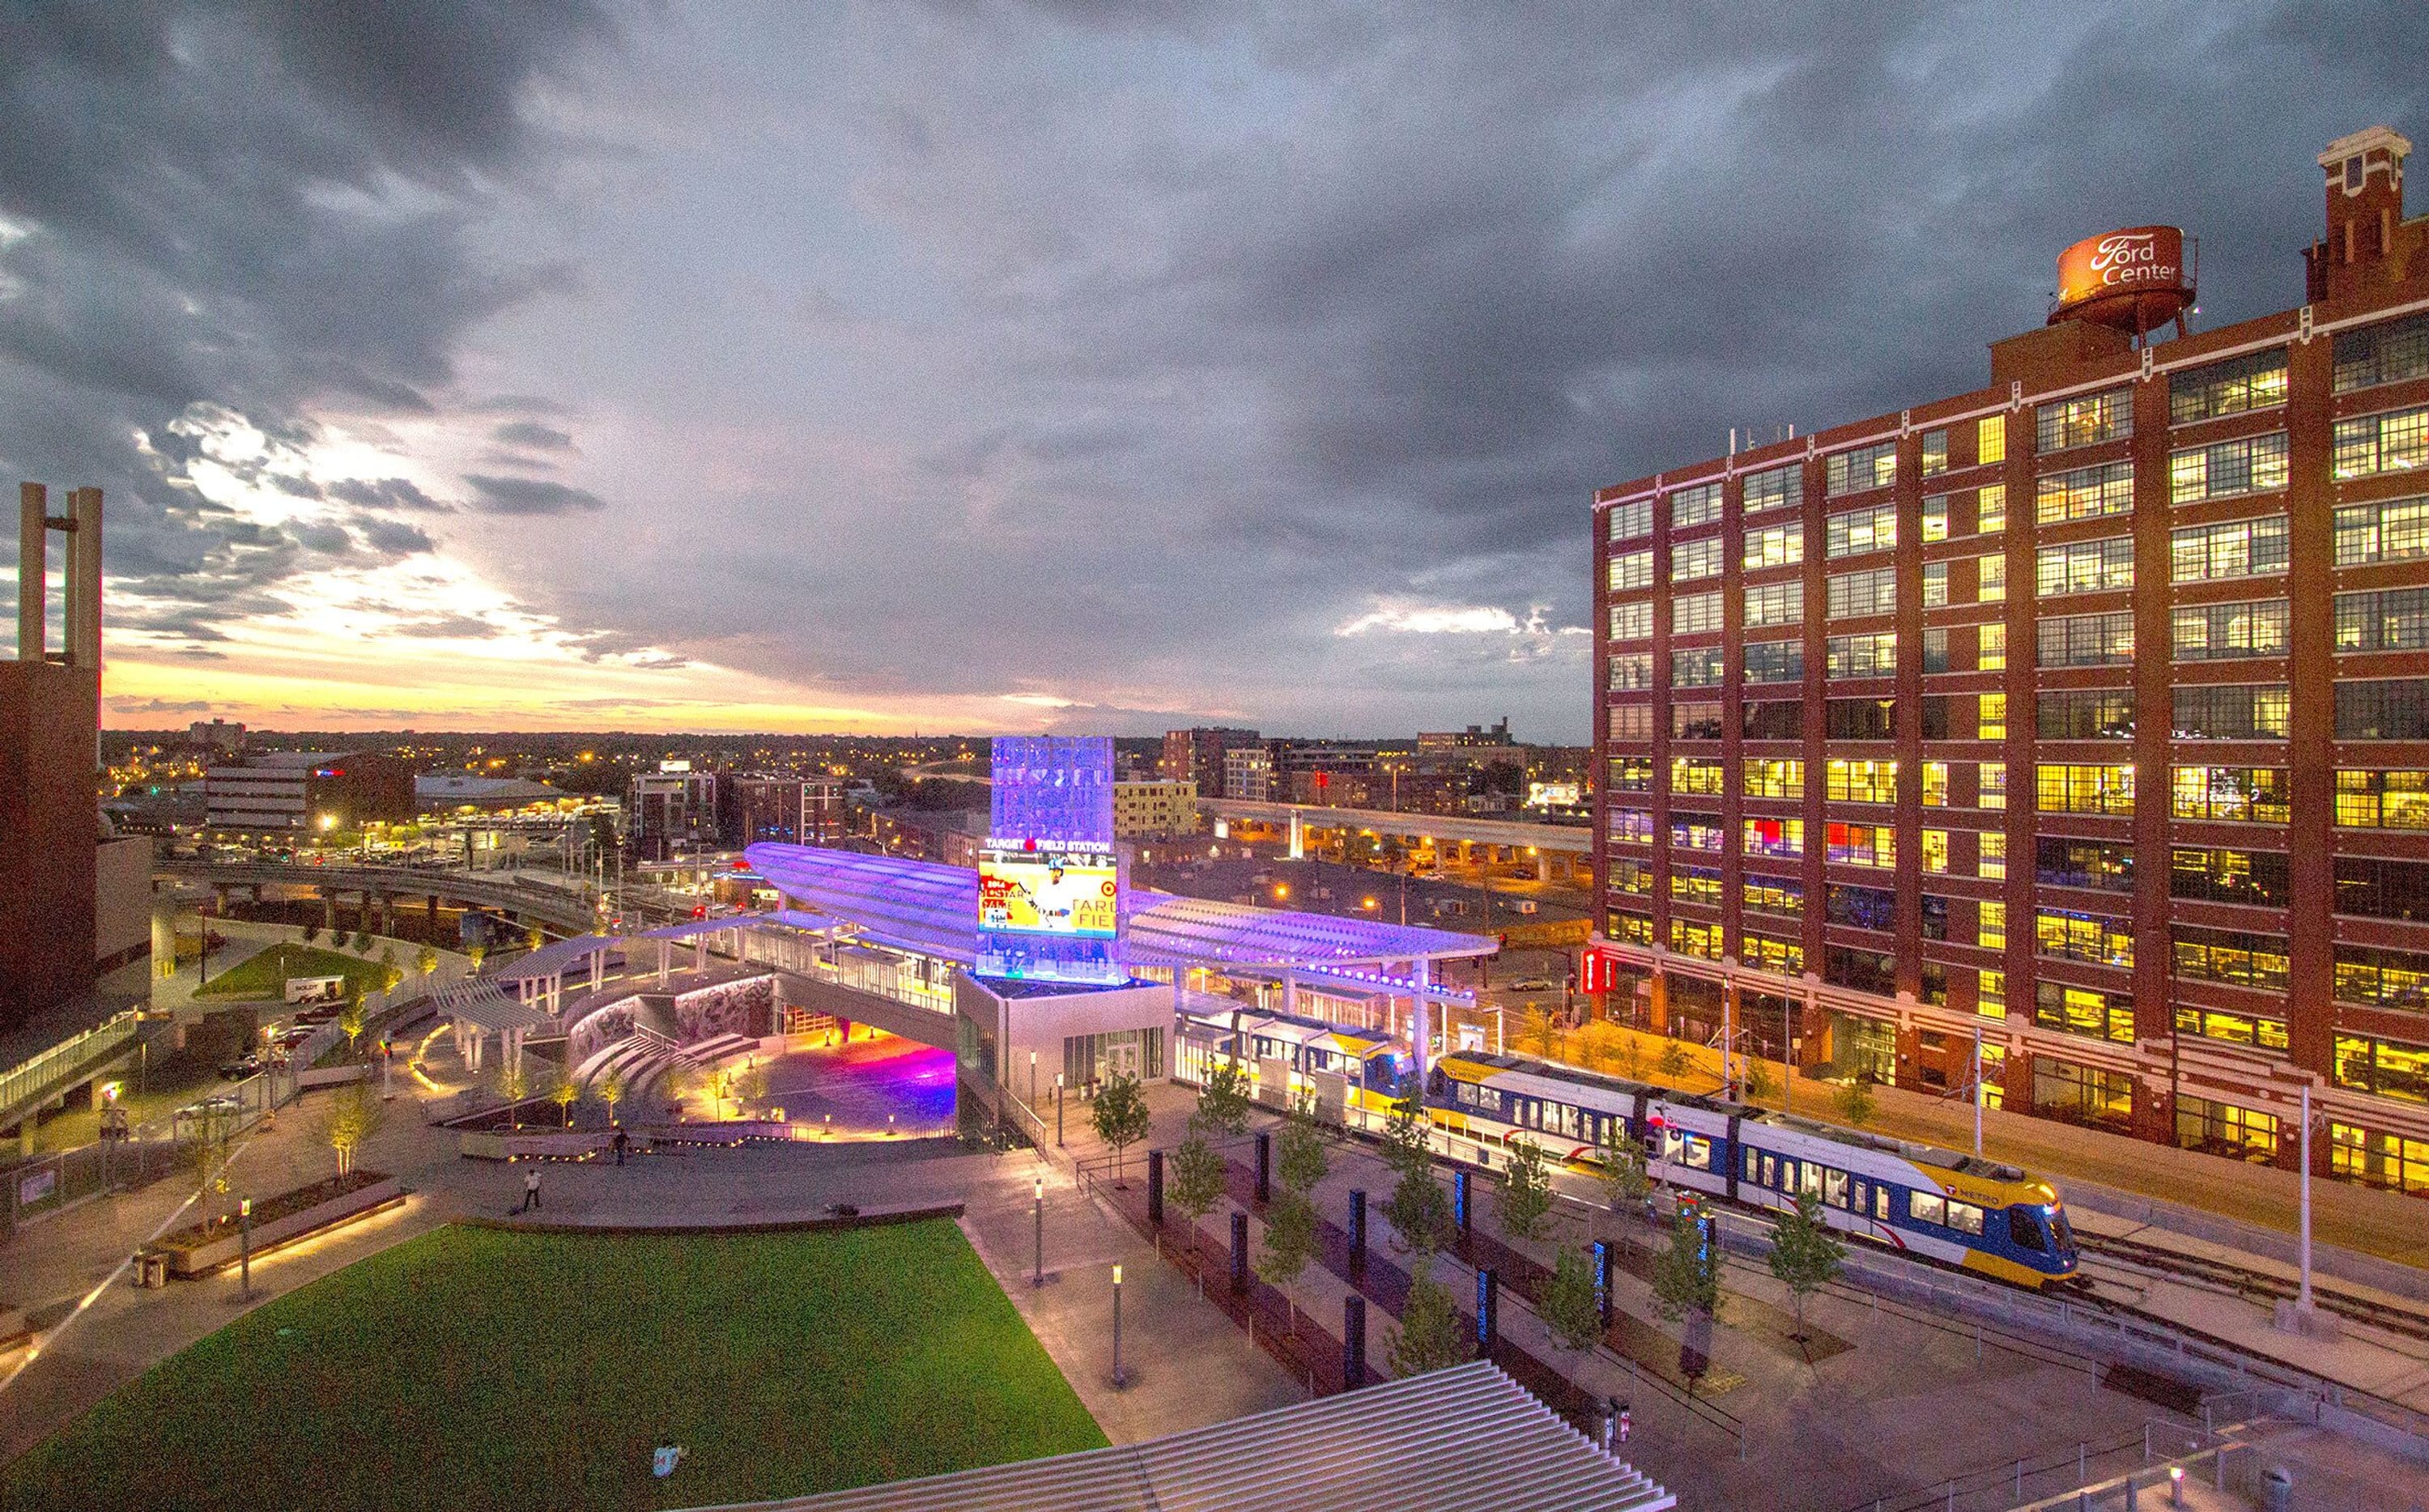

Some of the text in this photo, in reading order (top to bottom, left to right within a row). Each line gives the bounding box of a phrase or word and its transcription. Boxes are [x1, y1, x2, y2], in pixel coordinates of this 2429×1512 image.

[2090, 233, 2154, 270] Ford
[2103, 263, 2176, 286] Center
[985, 838, 1109, 852] TARGET FIELD STATION
[1960, 1189, 1998, 1204] METRO
